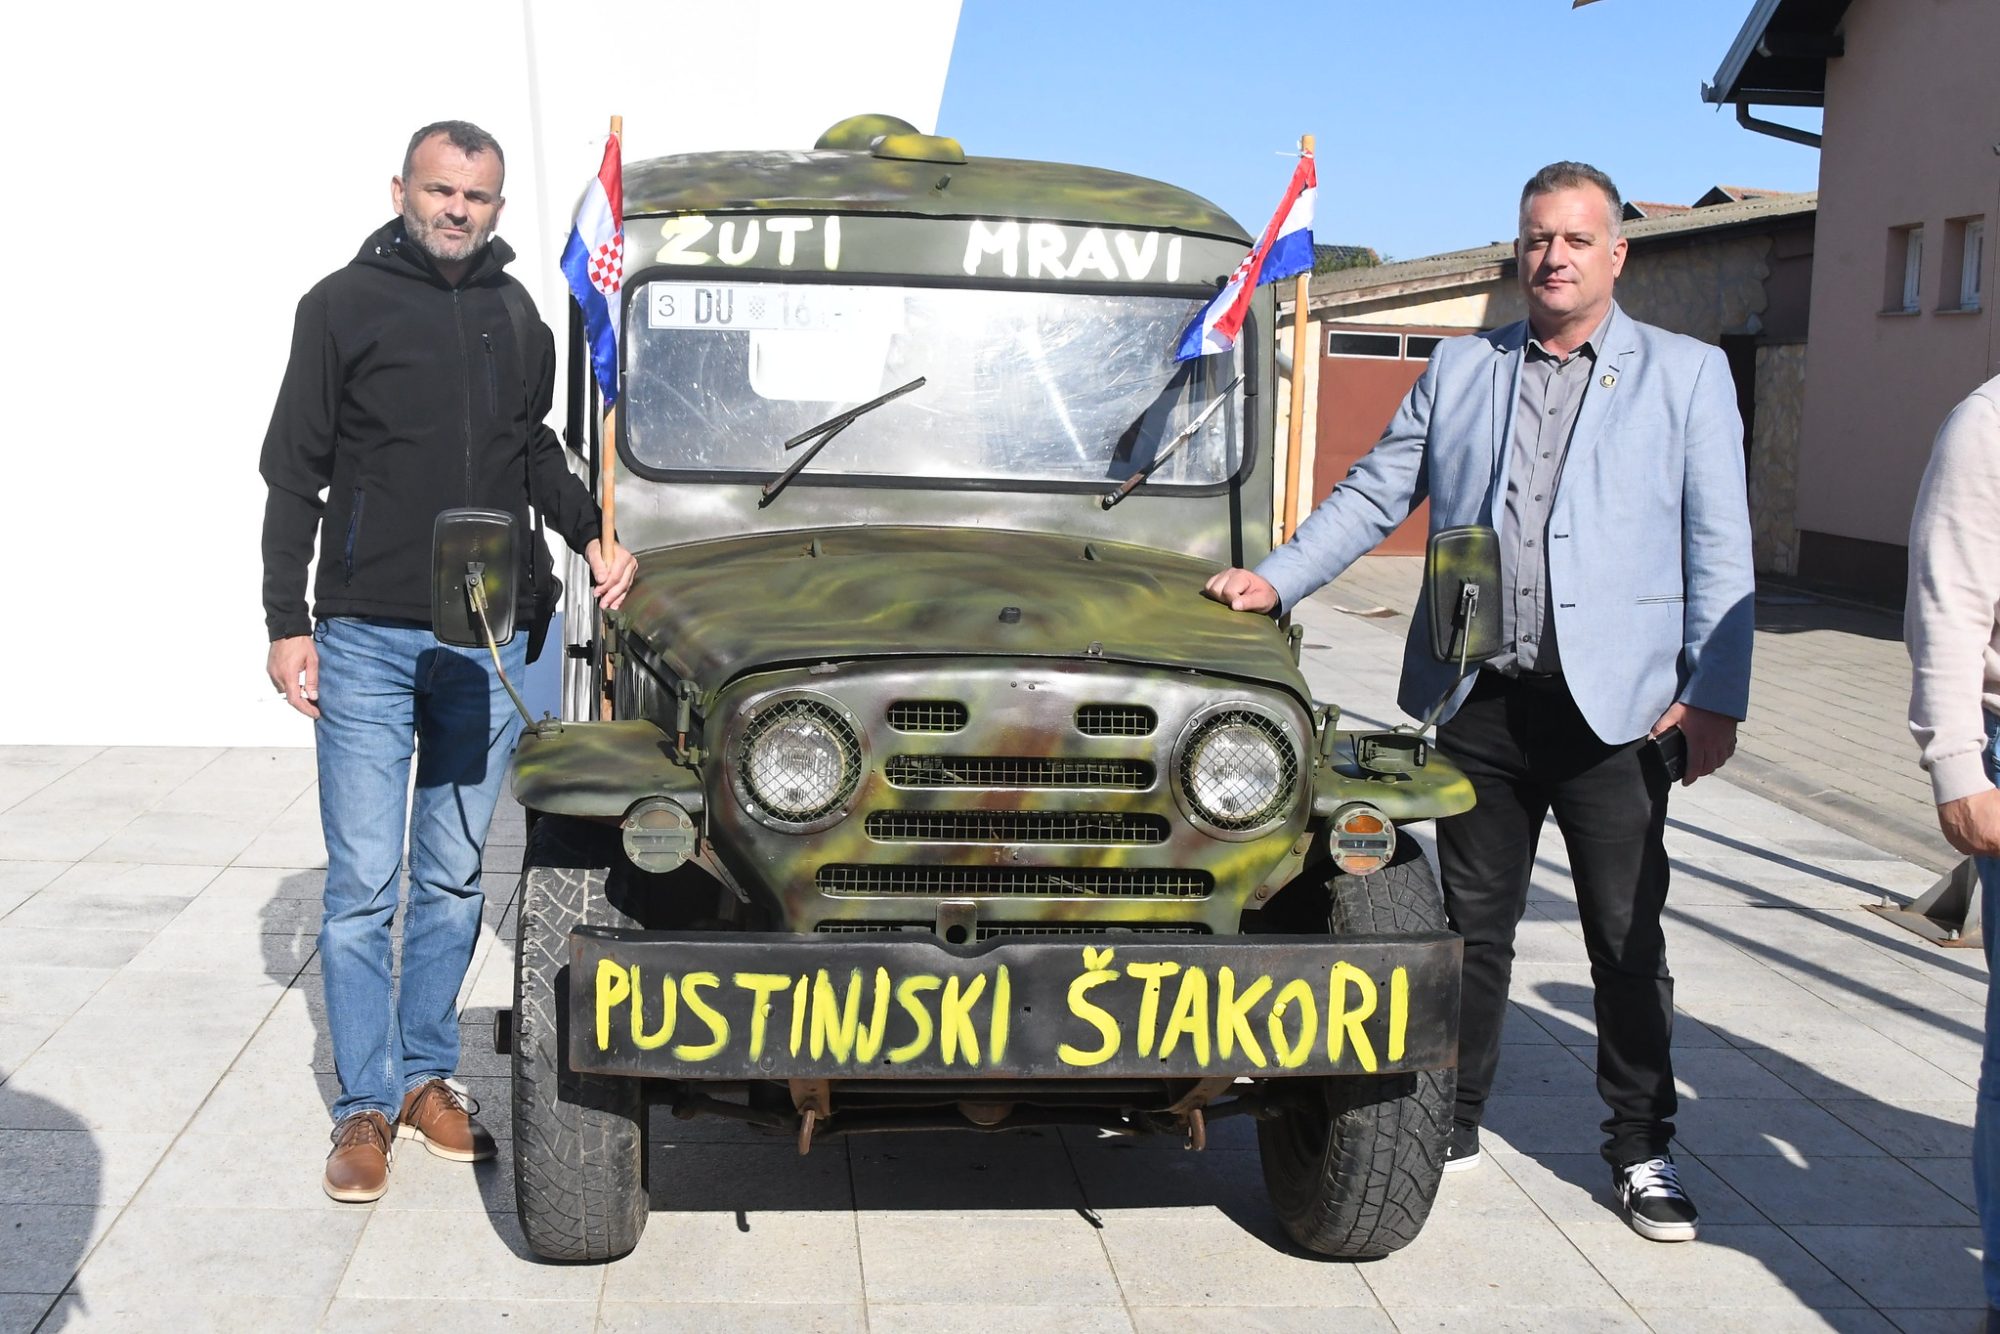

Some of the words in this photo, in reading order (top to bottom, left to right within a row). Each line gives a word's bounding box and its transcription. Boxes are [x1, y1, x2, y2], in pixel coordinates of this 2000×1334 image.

[963, 219, 1182, 282] MRAVI
[657, 294, 676, 318] 3
[695, 288, 734, 325] DU
[595, 958, 1010, 1068] PUSTINJSKI
[1057, 945, 1409, 1073] ŠTAKORI
